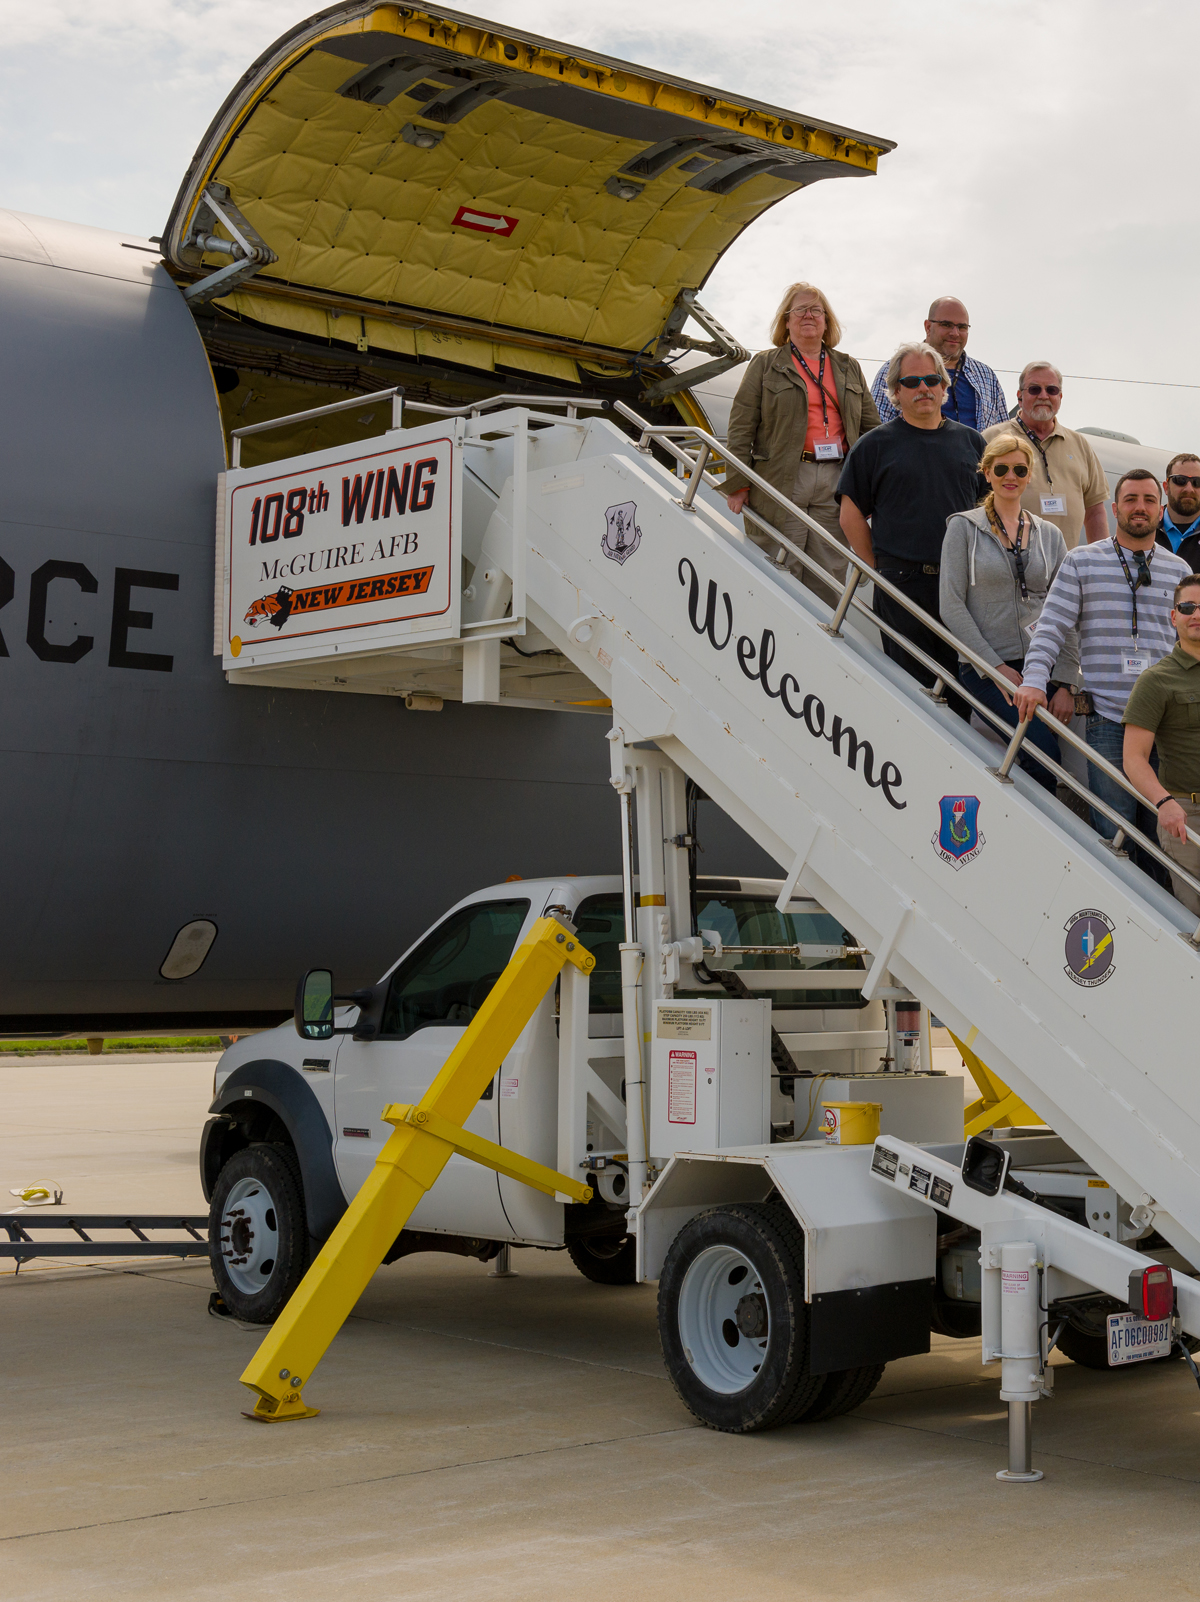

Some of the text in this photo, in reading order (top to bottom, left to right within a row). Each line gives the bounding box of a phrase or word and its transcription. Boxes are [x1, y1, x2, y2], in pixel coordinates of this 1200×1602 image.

[249, 456, 438, 546] 108th WING
[259, 532, 419, 582] McGUIRE AFB
[293, 570, 428, 611] NEW JERSEY
[678, 557, 907, 810] Welcome
[959, 847, 980, 865] WING
